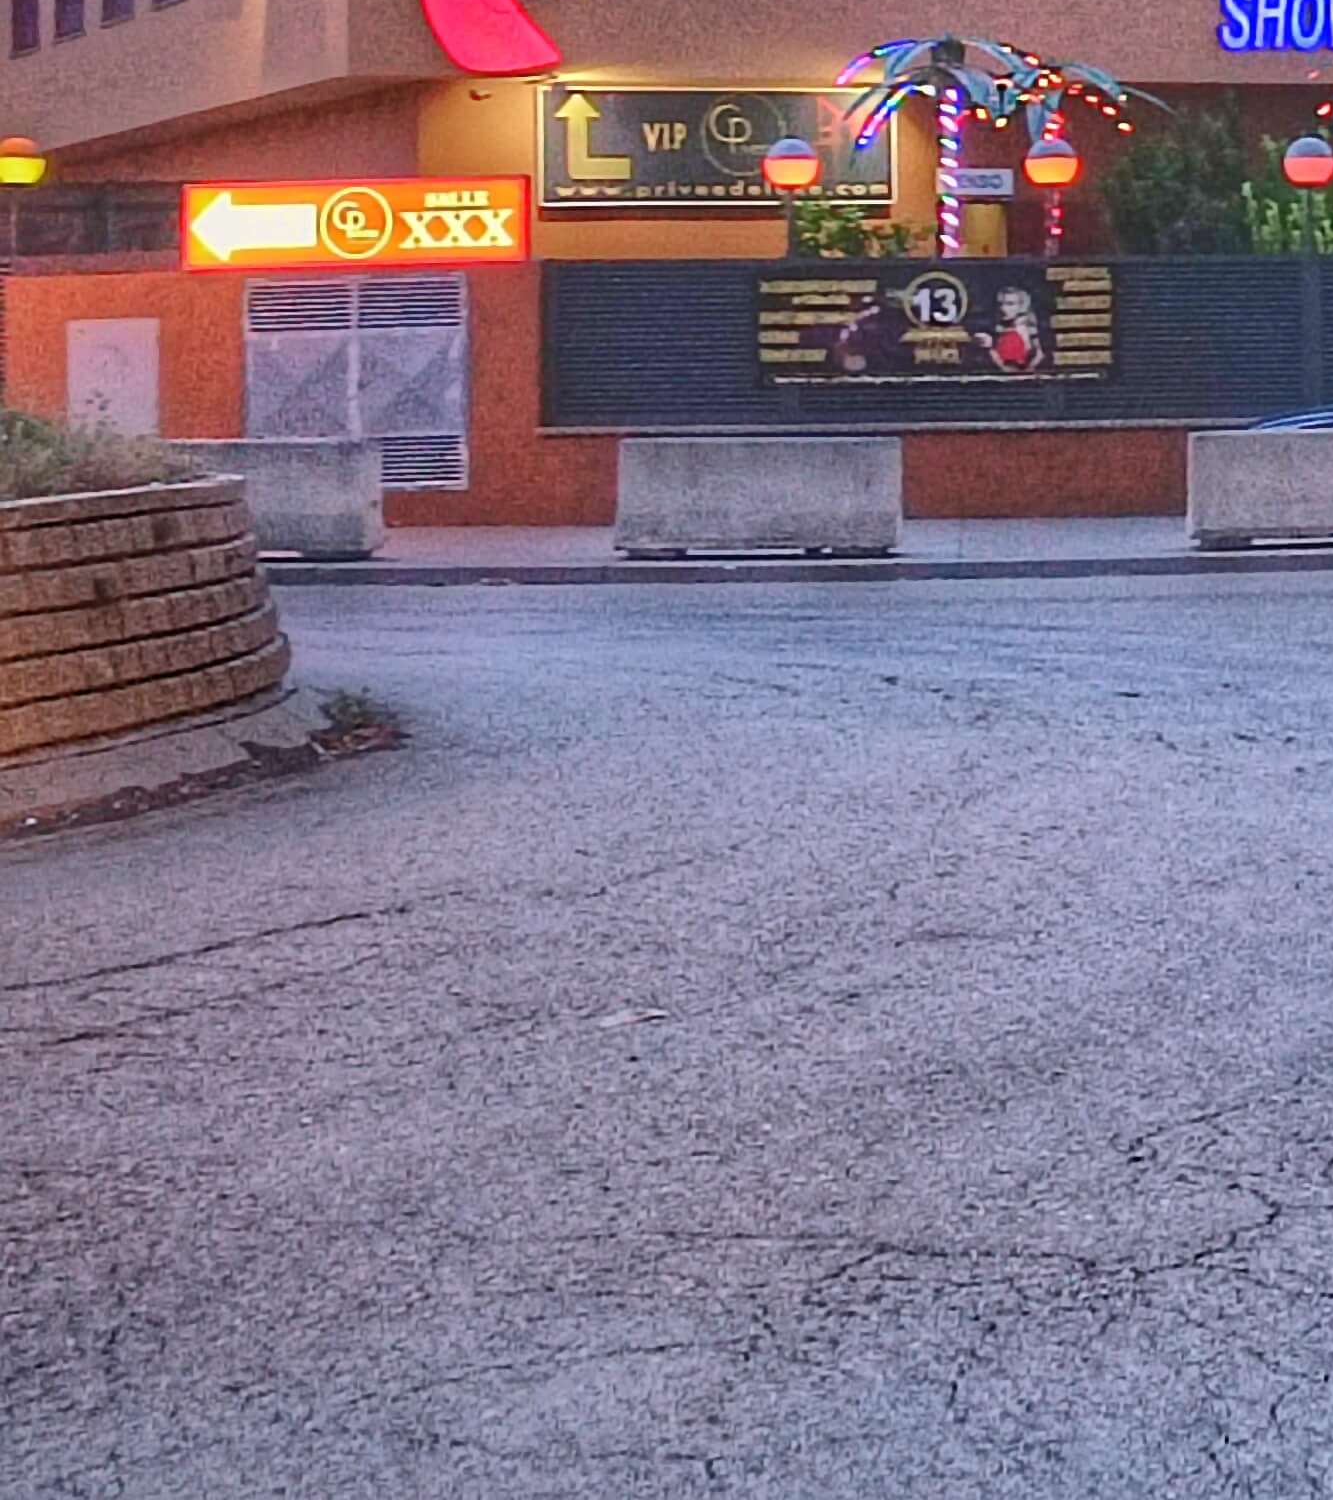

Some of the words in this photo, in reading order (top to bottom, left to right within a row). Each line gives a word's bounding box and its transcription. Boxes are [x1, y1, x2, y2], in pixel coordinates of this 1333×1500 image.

[642, 122, 688, 152] VIP
[398, 208, 514, 250] XXX
[912, 287, 958, 323] 13
